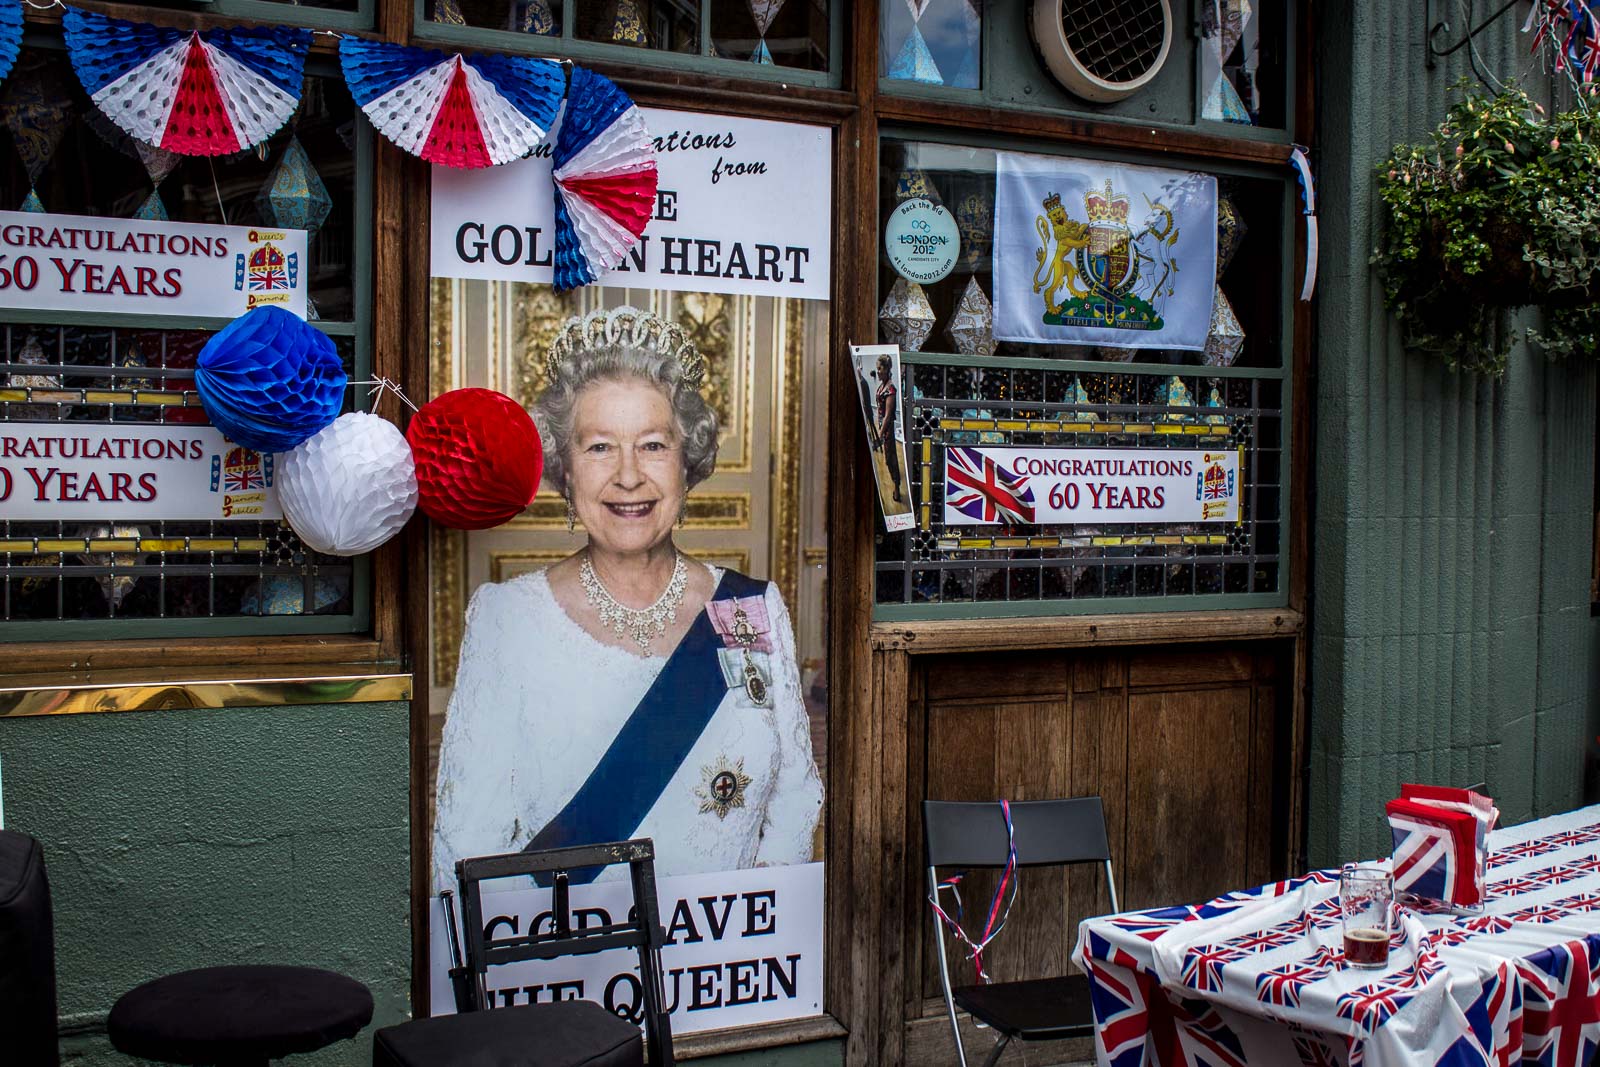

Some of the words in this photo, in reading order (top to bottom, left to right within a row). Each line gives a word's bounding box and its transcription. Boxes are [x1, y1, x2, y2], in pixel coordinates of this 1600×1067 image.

[712, 157, 767, 184] from
[901, 203, 917, 215] Back
[0, 225, 228, 257] GRATULATIONS
[455, 222, 650, 273] GOLN
[660, 236, 810, 283] HEART
[900, 234, 946, 246] LONDON
[912, 245, 935, 254] 2012
[49, 257, 182, 297] YEARS
[894, 256, 902, 265] at
[901, 258, 952, 280] london2012.com
[0, 437, 203, 459] RATULATIONS
[1013, 456, 1192, 476] CONGRATULATIONS
[24, 467, 157, 501] YEARS
[1048, 483, 1080, 510] 60
[1086, 483, 1165, 509] YEARS
[628, 890, 776, 948] AVE
